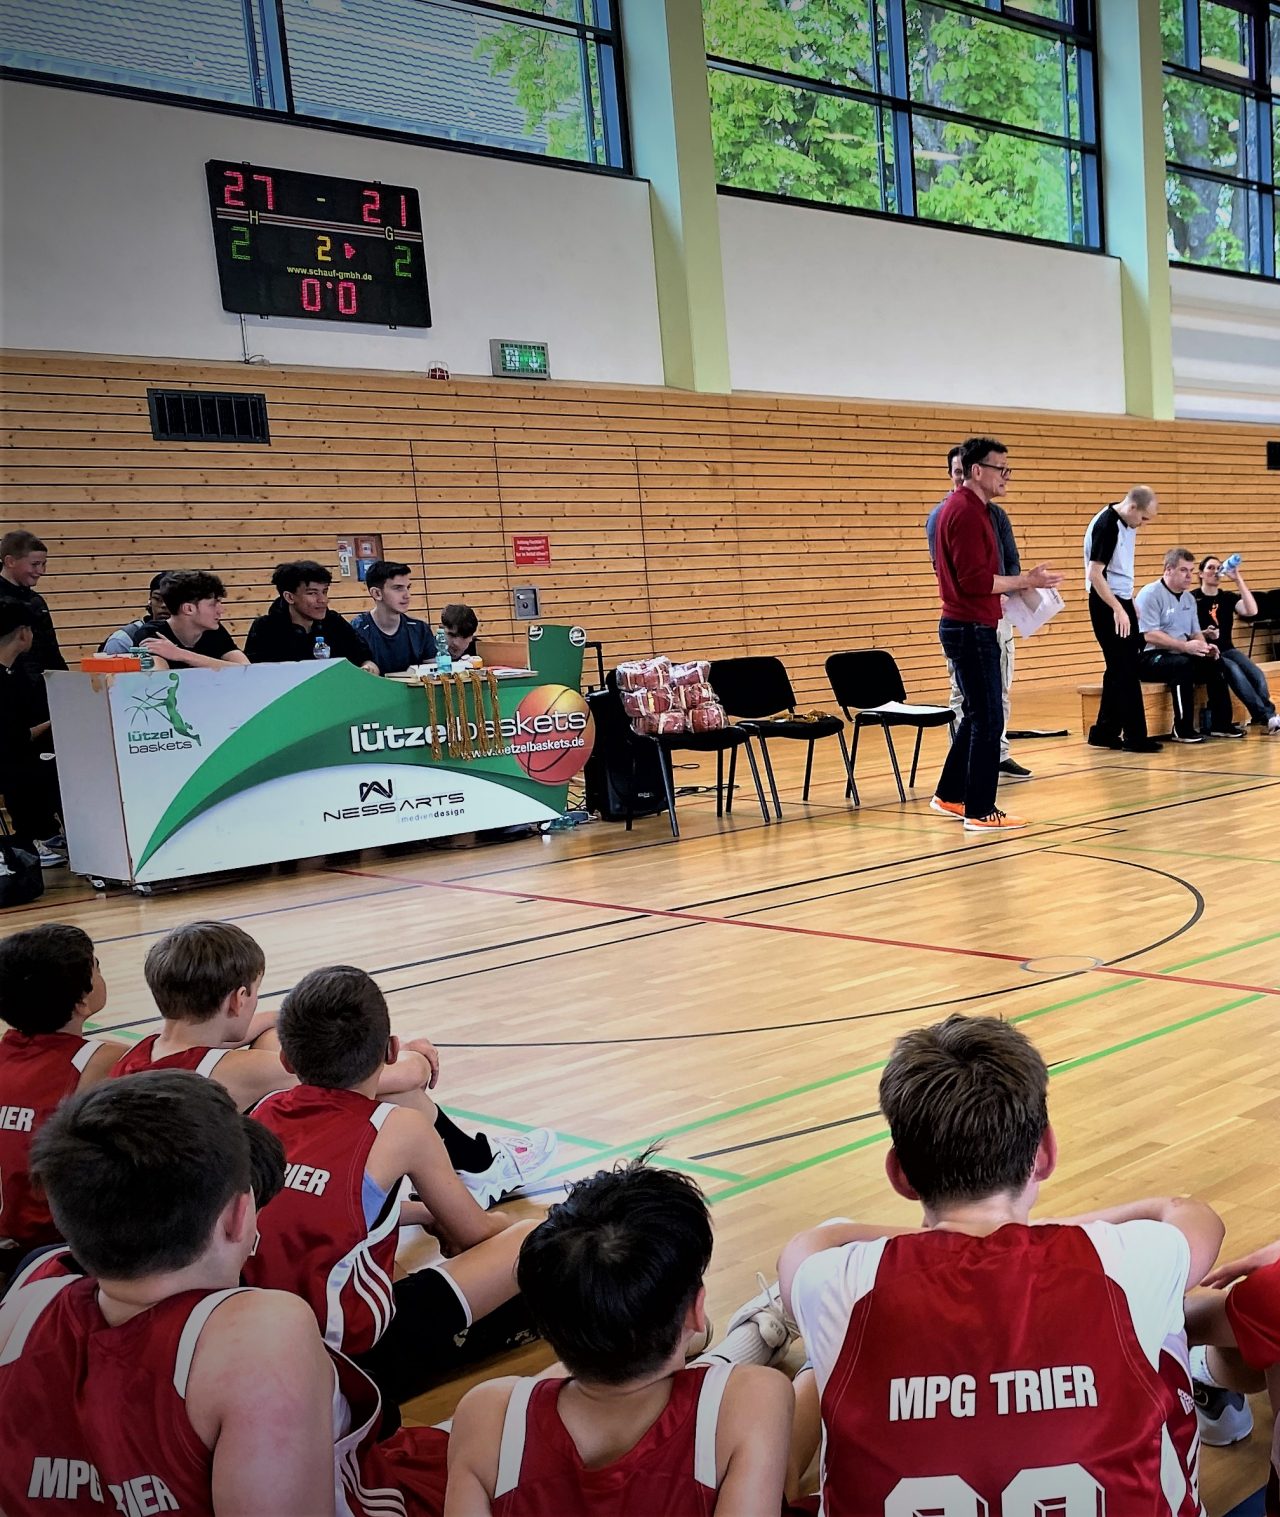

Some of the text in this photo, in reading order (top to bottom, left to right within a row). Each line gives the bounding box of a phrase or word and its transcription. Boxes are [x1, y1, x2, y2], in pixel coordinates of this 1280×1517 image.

[223, 170, 274, 210] 27
[362, 190, 407, 227] 21
[249, 211, 259, 225] H
[230, 226, 251, 260] 2
[384, 226, 394, 241] G
[317, 236, 332, 262] 2
[395, 245, 412, 278] 2
[286, 265, 373, 281] www.schauf-gmbh.de
[127, 728, 174, 742] lützel
[350, 709, 587, 753] lützebaskets
[128, 740, 193, 754] baskets
[0, 1105, 35, 1132] IER
[284, 1162, 331, 1197] IER
[889, 1366, 1098, 1421] MPG TRIER
[108, 1474, 180, 1517] RIER
